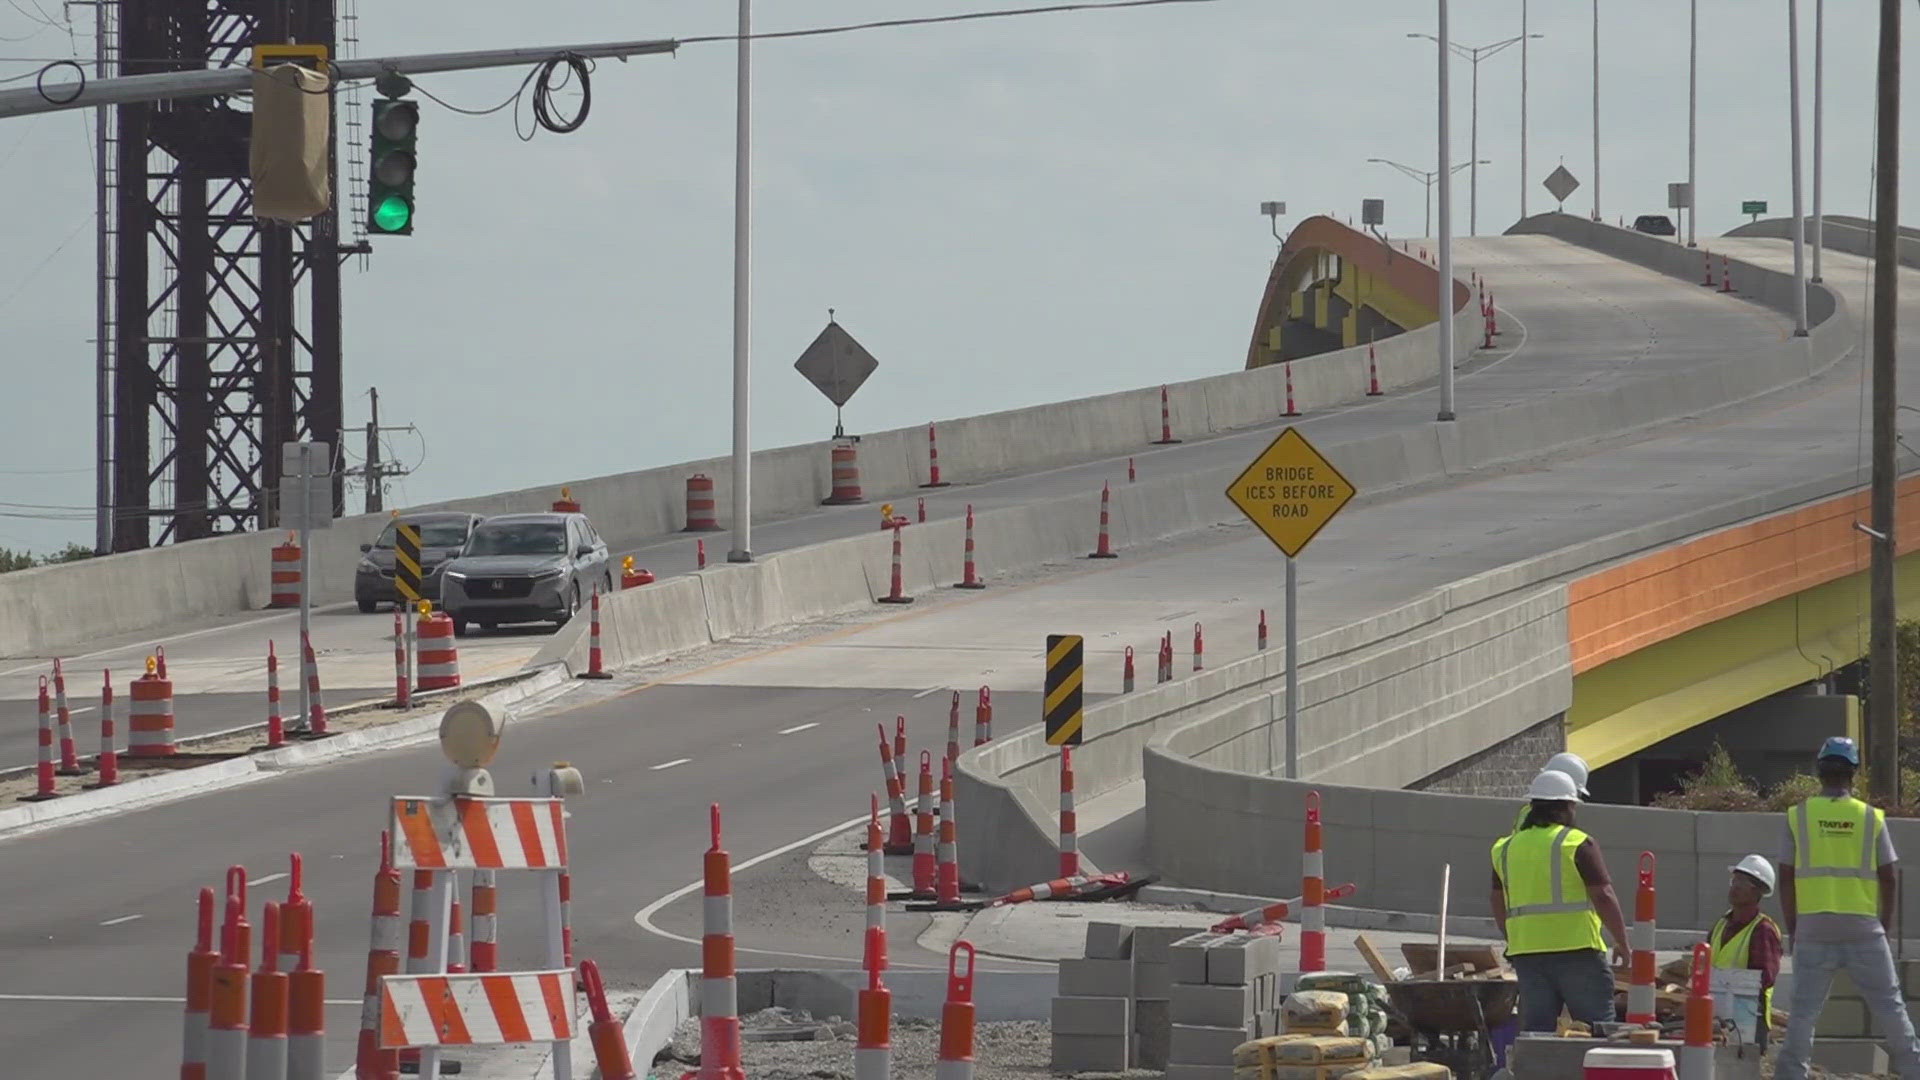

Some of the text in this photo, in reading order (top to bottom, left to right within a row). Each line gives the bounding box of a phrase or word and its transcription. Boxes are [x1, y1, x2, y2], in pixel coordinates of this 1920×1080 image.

[1266, 467, 1314, 480] BRIDGE
[1246, 485, 1334, 499] ICES BEFORE
[1272, 504, 1308, 517] ROAD
